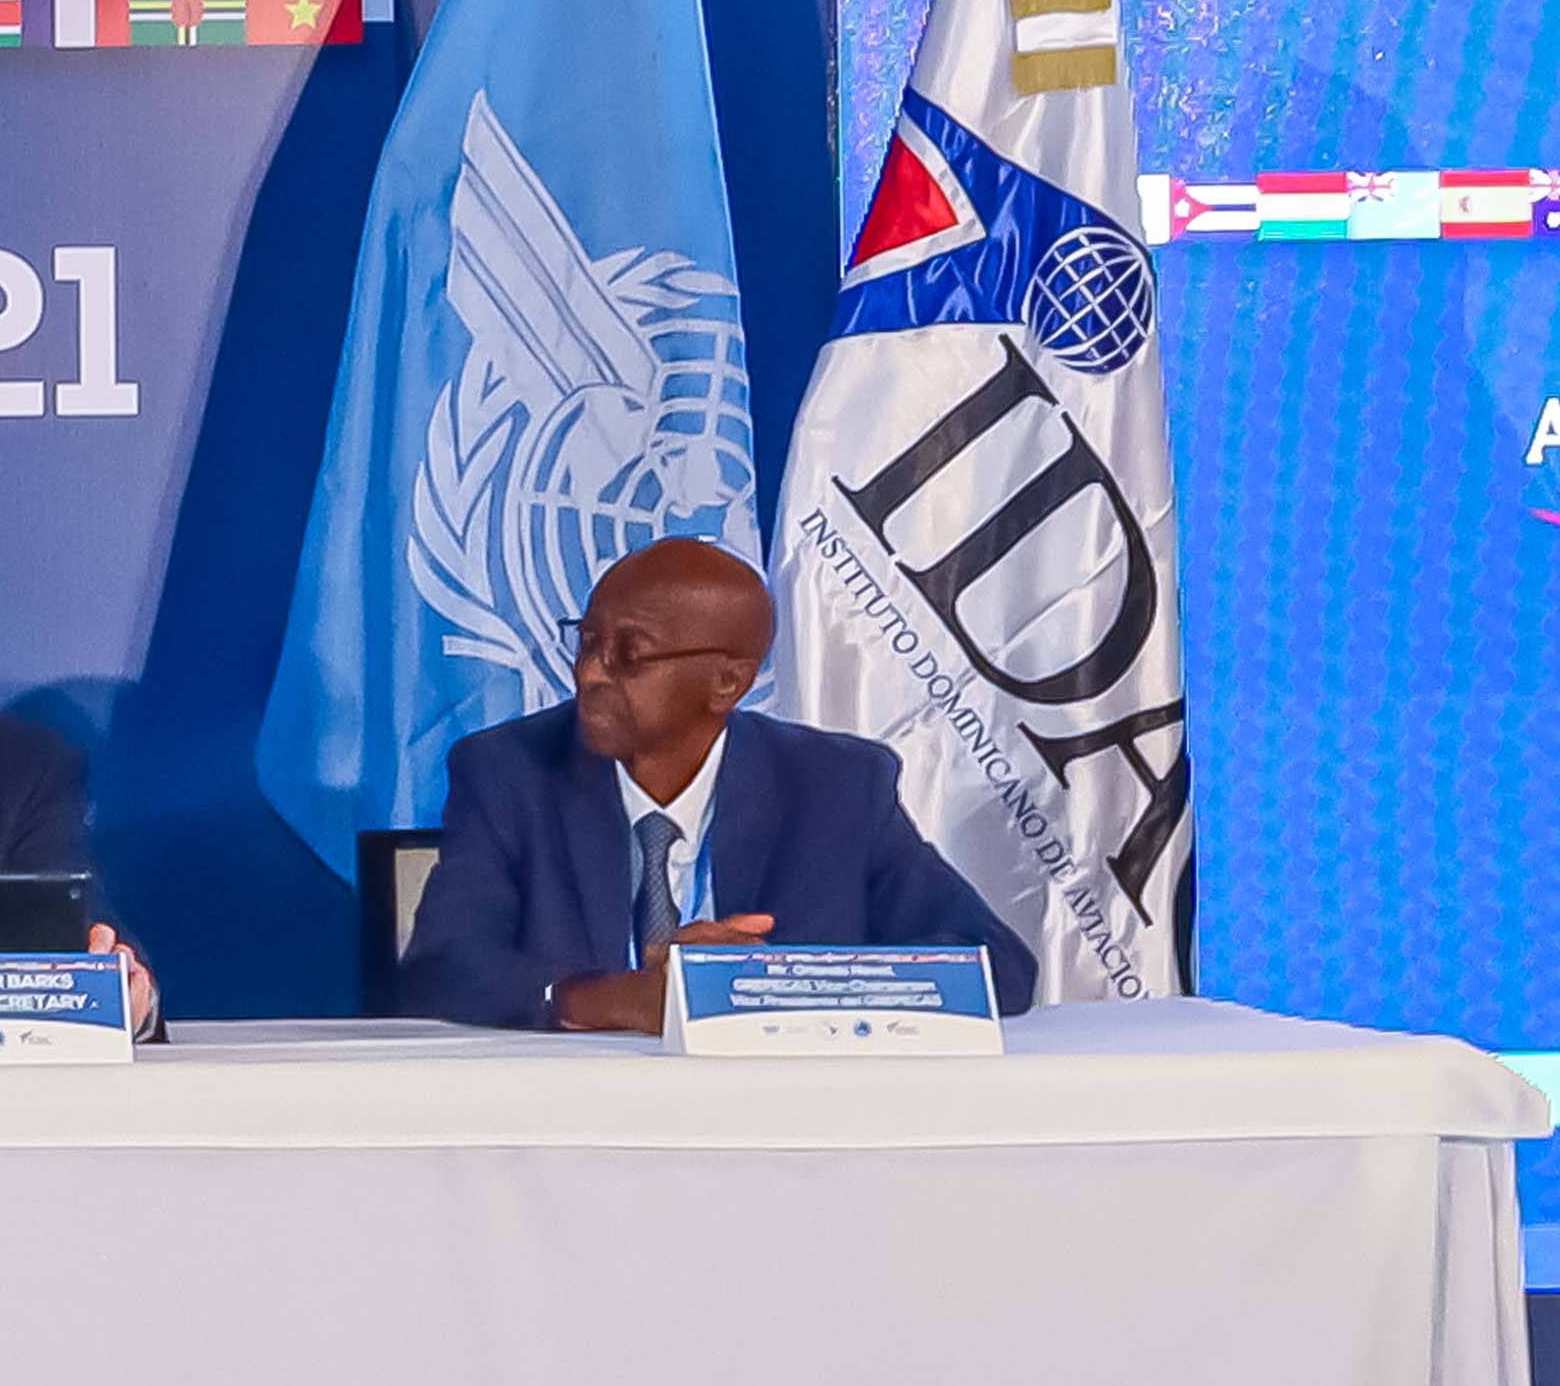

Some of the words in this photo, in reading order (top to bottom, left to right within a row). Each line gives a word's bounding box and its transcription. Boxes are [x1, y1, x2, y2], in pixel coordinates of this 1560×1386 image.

[799, 508, 918, 655] INSTITUTO
[912, 652, 1046, 838] DOMINICANO
[1034, 839, 1078, 885] DE
[1065, 886, 1149, 1000] AVIACIO
[832, 333, 1186, 928] IDA
